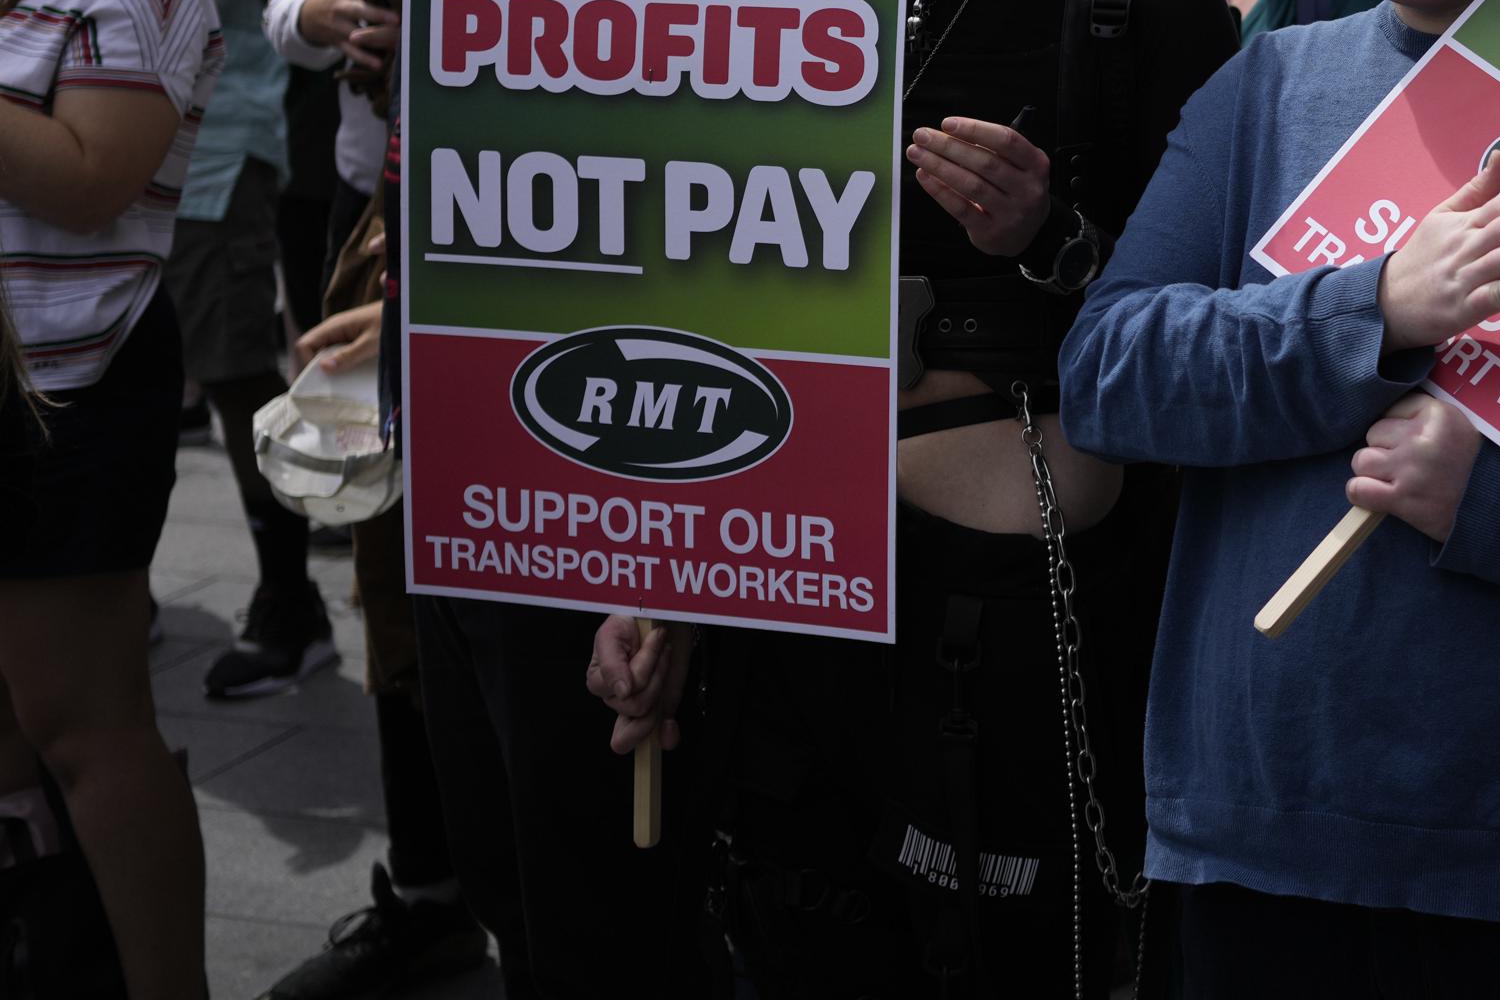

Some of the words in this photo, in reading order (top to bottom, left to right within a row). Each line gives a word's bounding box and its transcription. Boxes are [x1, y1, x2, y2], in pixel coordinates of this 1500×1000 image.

[430, 148, 646, 256] NOT
[664, 160, 876, 271] PAY
[576, 376, 732, 434] RMT
[463, 484, 706, 550] SUPPORT
[720, 508, 835, 563] OUR
[426, 536, 660, 590] TRANSPORT
[671, 561, 874, 613] WORKERS
